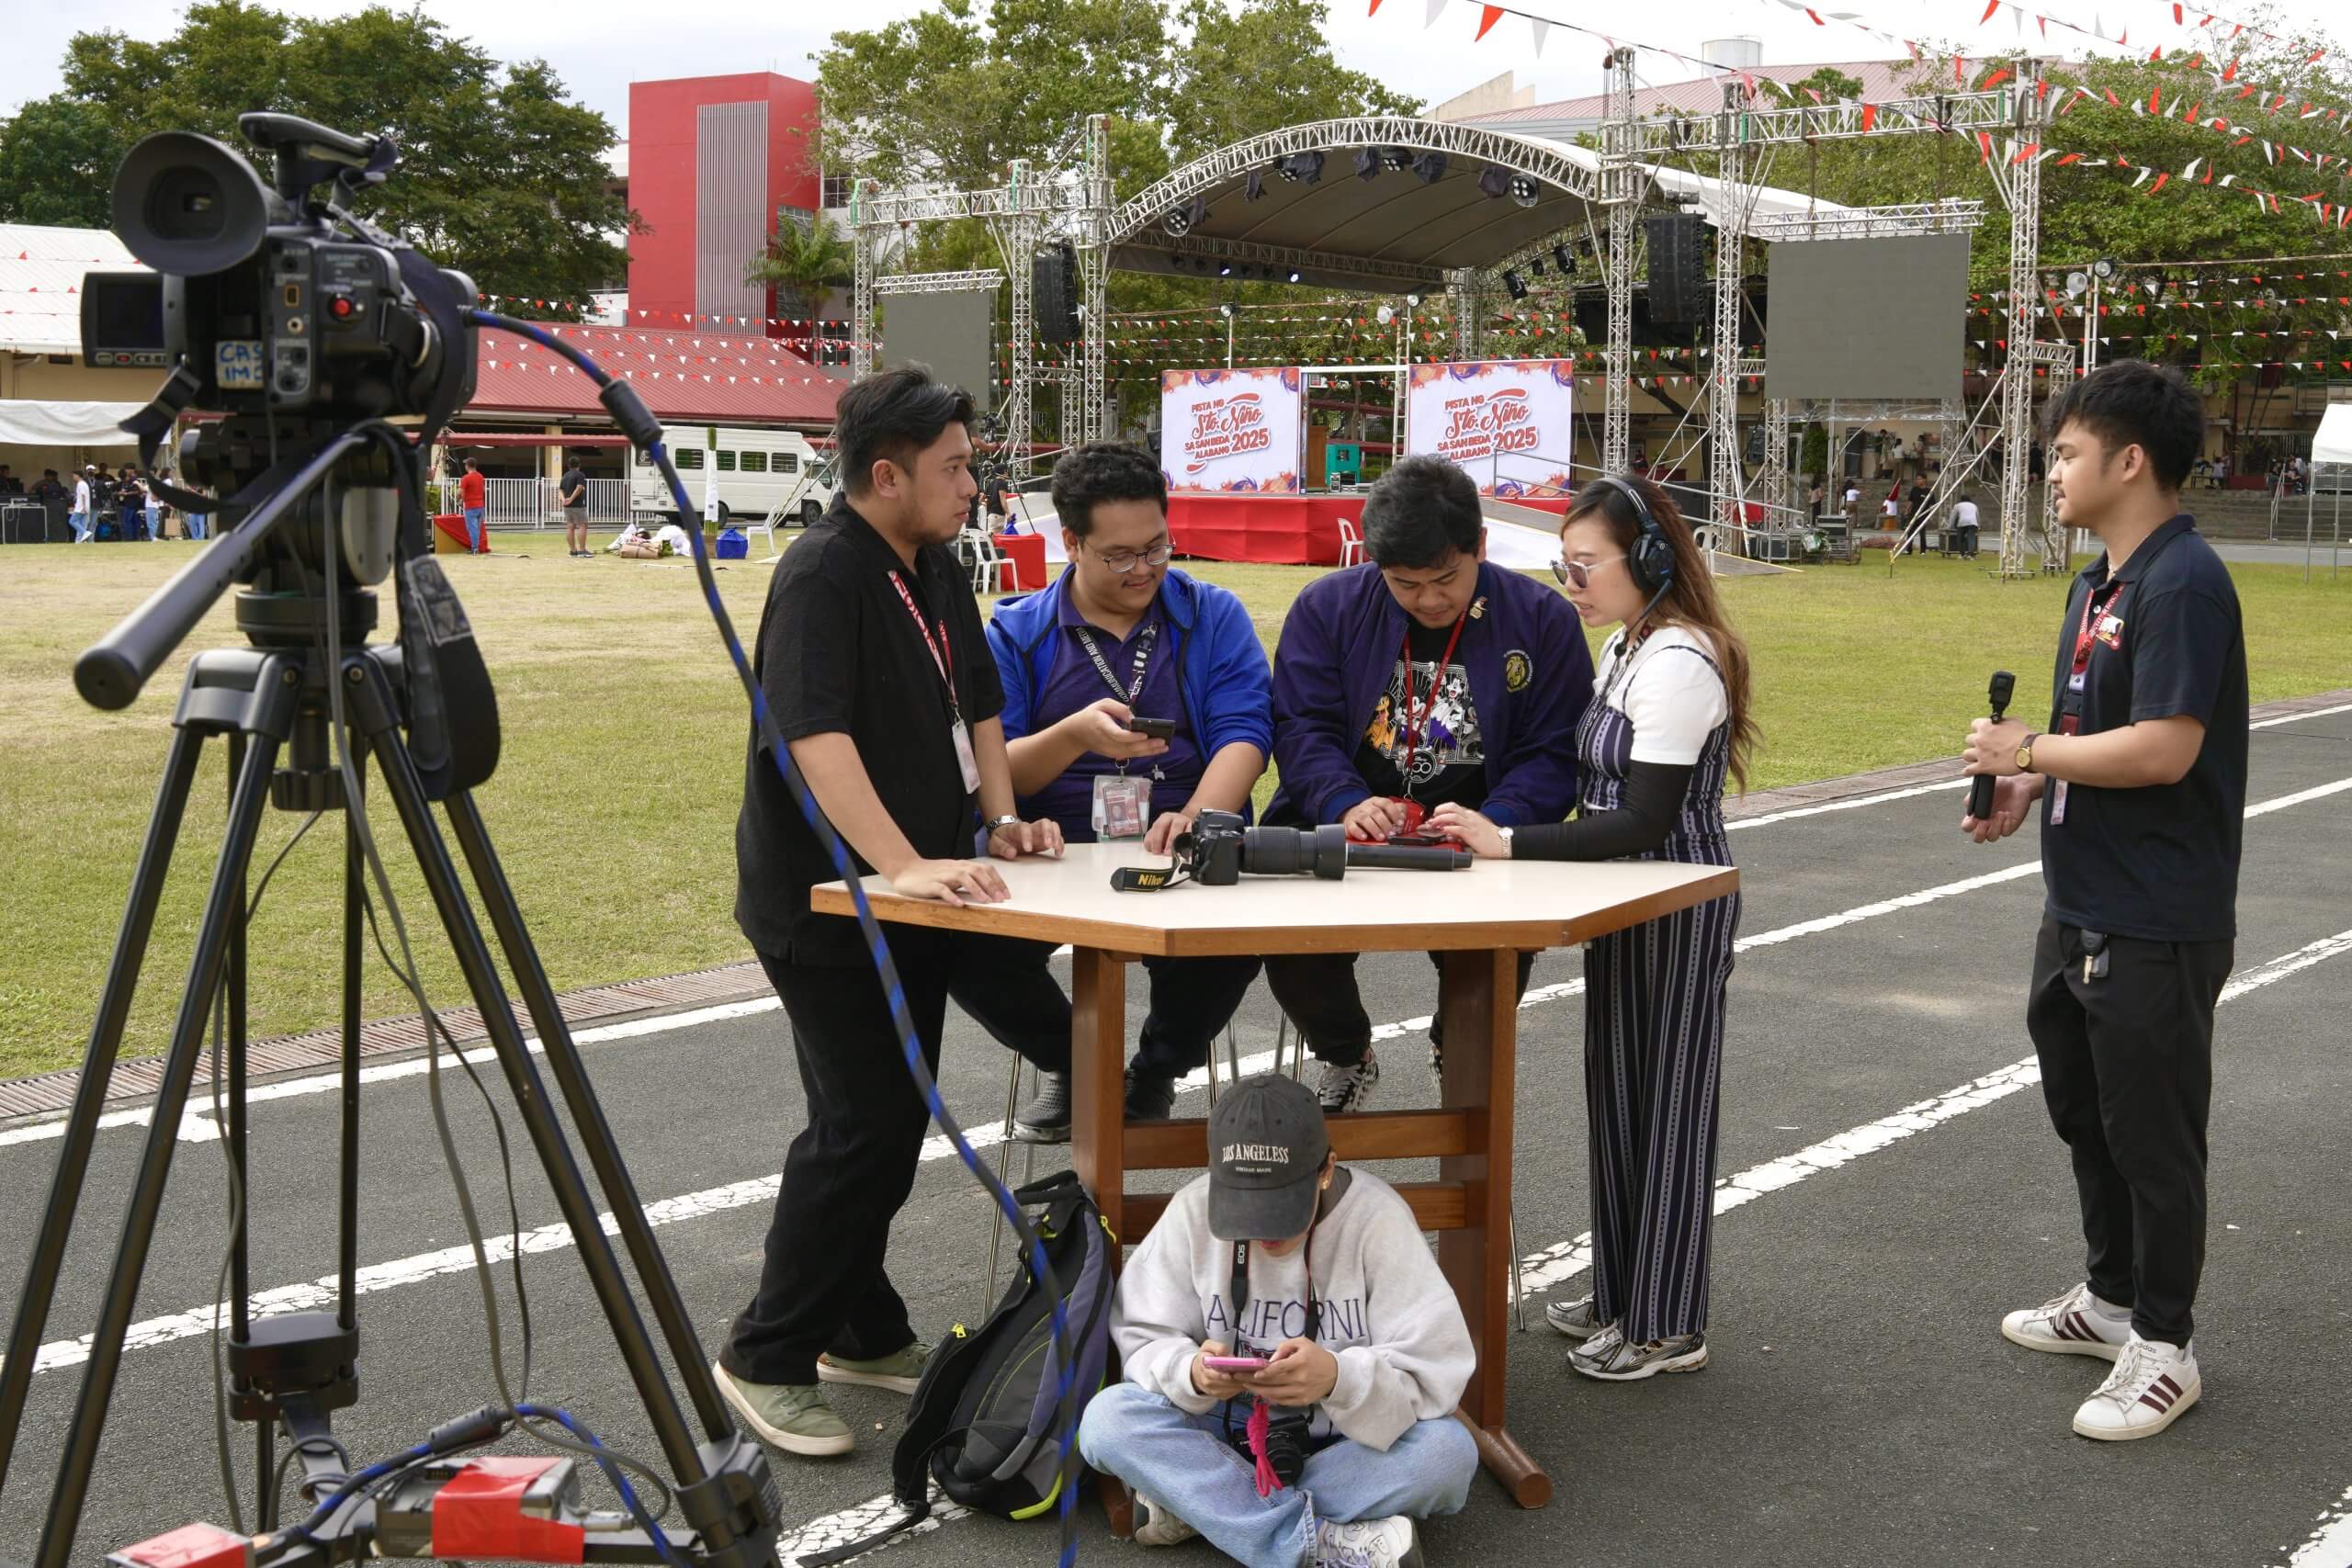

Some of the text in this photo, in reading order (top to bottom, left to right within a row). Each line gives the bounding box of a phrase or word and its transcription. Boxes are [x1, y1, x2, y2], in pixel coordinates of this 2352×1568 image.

[1192, 399, 1225, 412] PISTA NG
[1445, 395, 1485, 410] PISTA NG
[1192, 405, 1262, 439] Sto. Niño
[1445, 401, 1529, 439] Sto. Niño
[1184, 434, 1230, 451] SA SAN BEDA
[1231, 428, 1269, 451] 2025
[1437, 434, 1491, 451] SA SAN BEDA
[1494, 426, 1537, 450] 2025
[1194, 446, 1230, 459] ALABANG
[1449, 446, 1491, 460] ALABANG
[1085, 642, 1100, 656] AND
[1091, 653, 1130, 703] COMMUNICATION
[1409, 761, 1433, 774] 00
[1221, 1143, 1289, 1164] LOS ANGELESS
[1238, 1244, 1246, 1265] EOS
